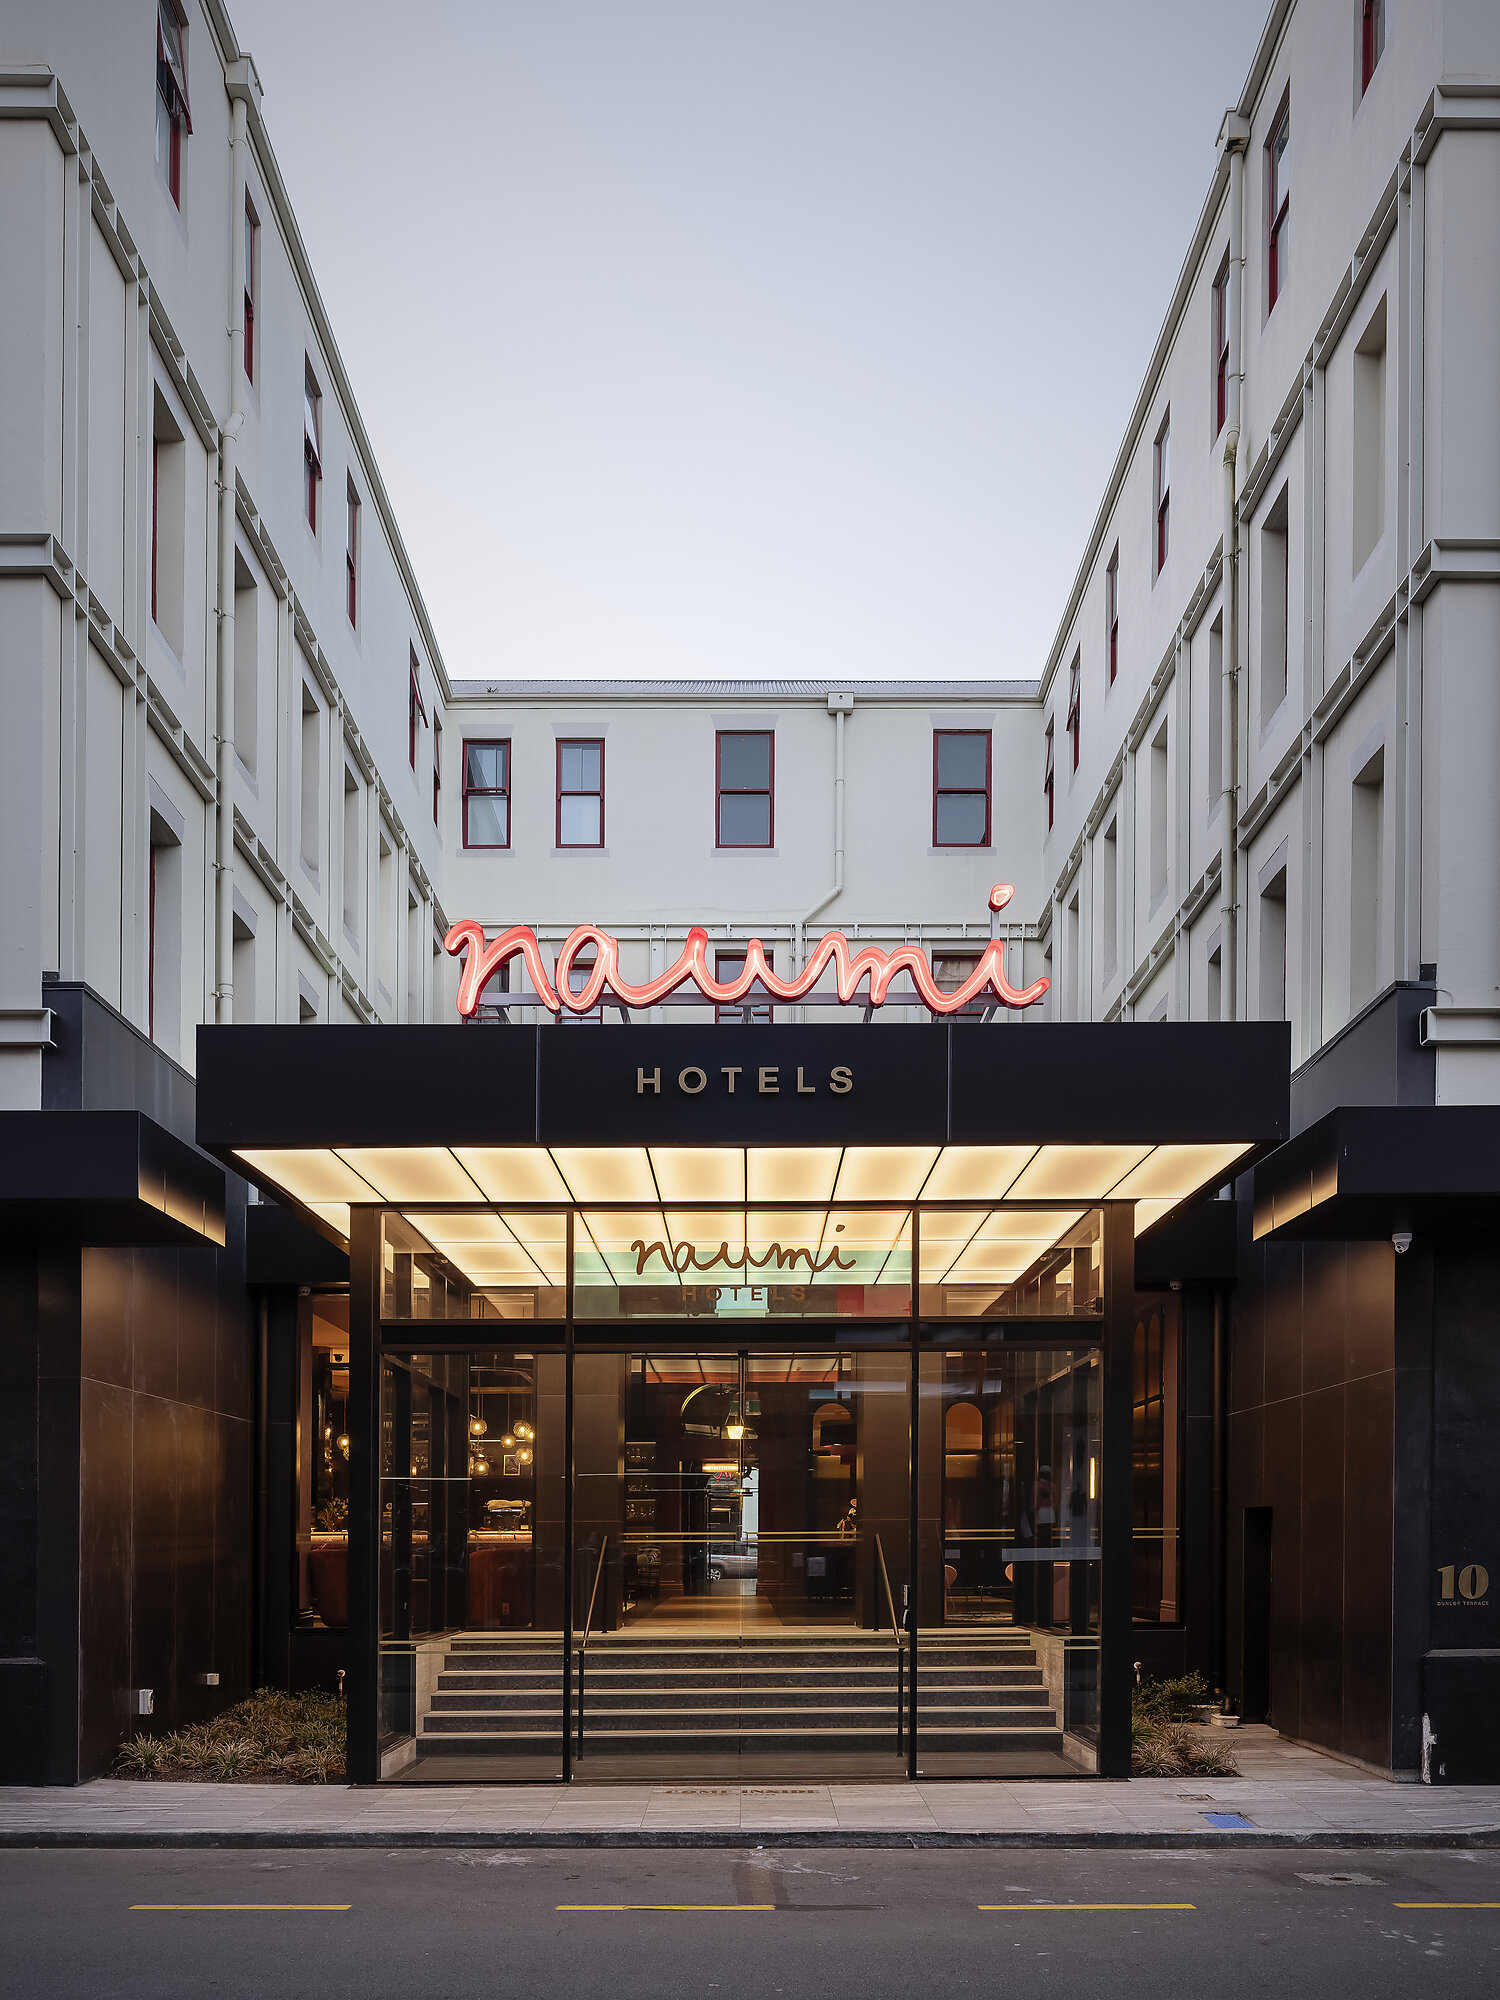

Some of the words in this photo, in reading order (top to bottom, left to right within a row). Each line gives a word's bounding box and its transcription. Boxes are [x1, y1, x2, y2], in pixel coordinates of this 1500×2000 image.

[444, 883, 1051, 1017] naumi
[636, 1066, 855, 1094] HOTELS
[631, 1224, 856, 1276] naumi
[681, 1285, 806, 1302] HOTELS
[1437, 1564, 1489, 1600] 10
